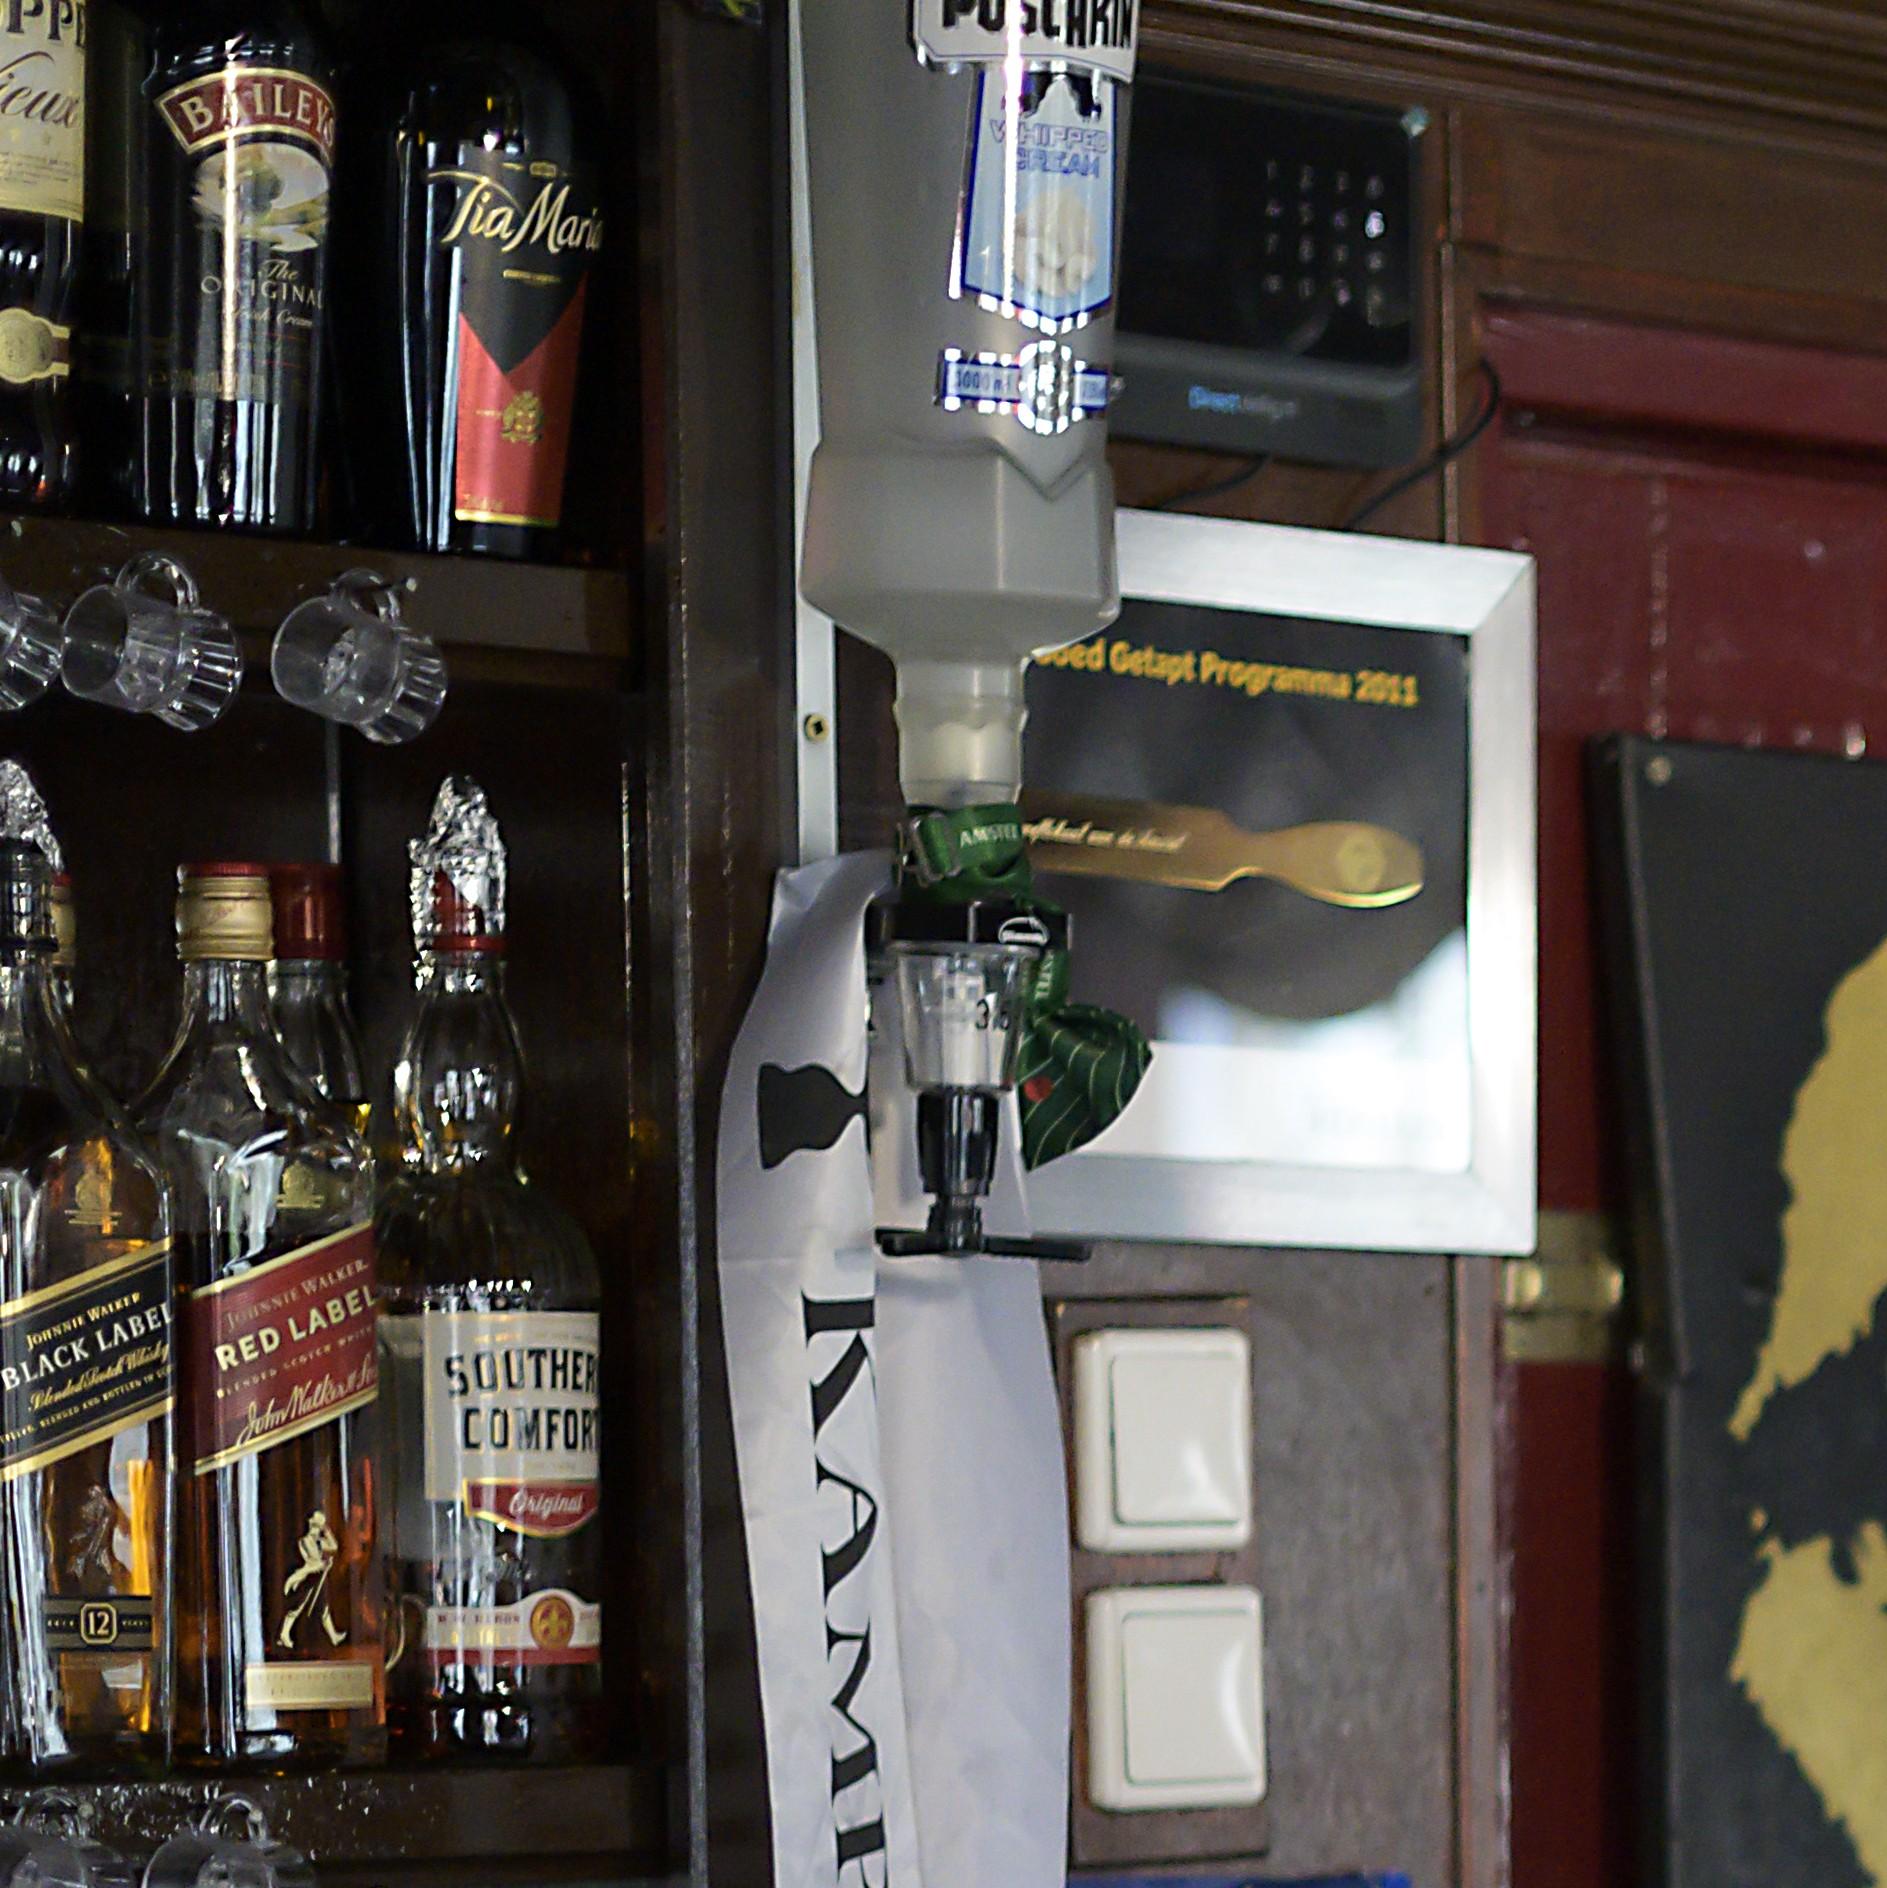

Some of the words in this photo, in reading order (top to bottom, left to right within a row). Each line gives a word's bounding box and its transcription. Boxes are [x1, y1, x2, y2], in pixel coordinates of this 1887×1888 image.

[428, 171, 524, 244] Tia
[1200, 651, 1353, 697] Programma
[959, 823, 1020, 849] AMSTEL
[1, 1336, 89, 1391] BLACK
[94, 1301, 173, 1352] LABEL
[214, 1326, 281, 1372] RED
[287, 1284, 376, 1342] LABEL
[509, 1486, 585, 1521] Original
[87, 1610, 110, 1637] 12
